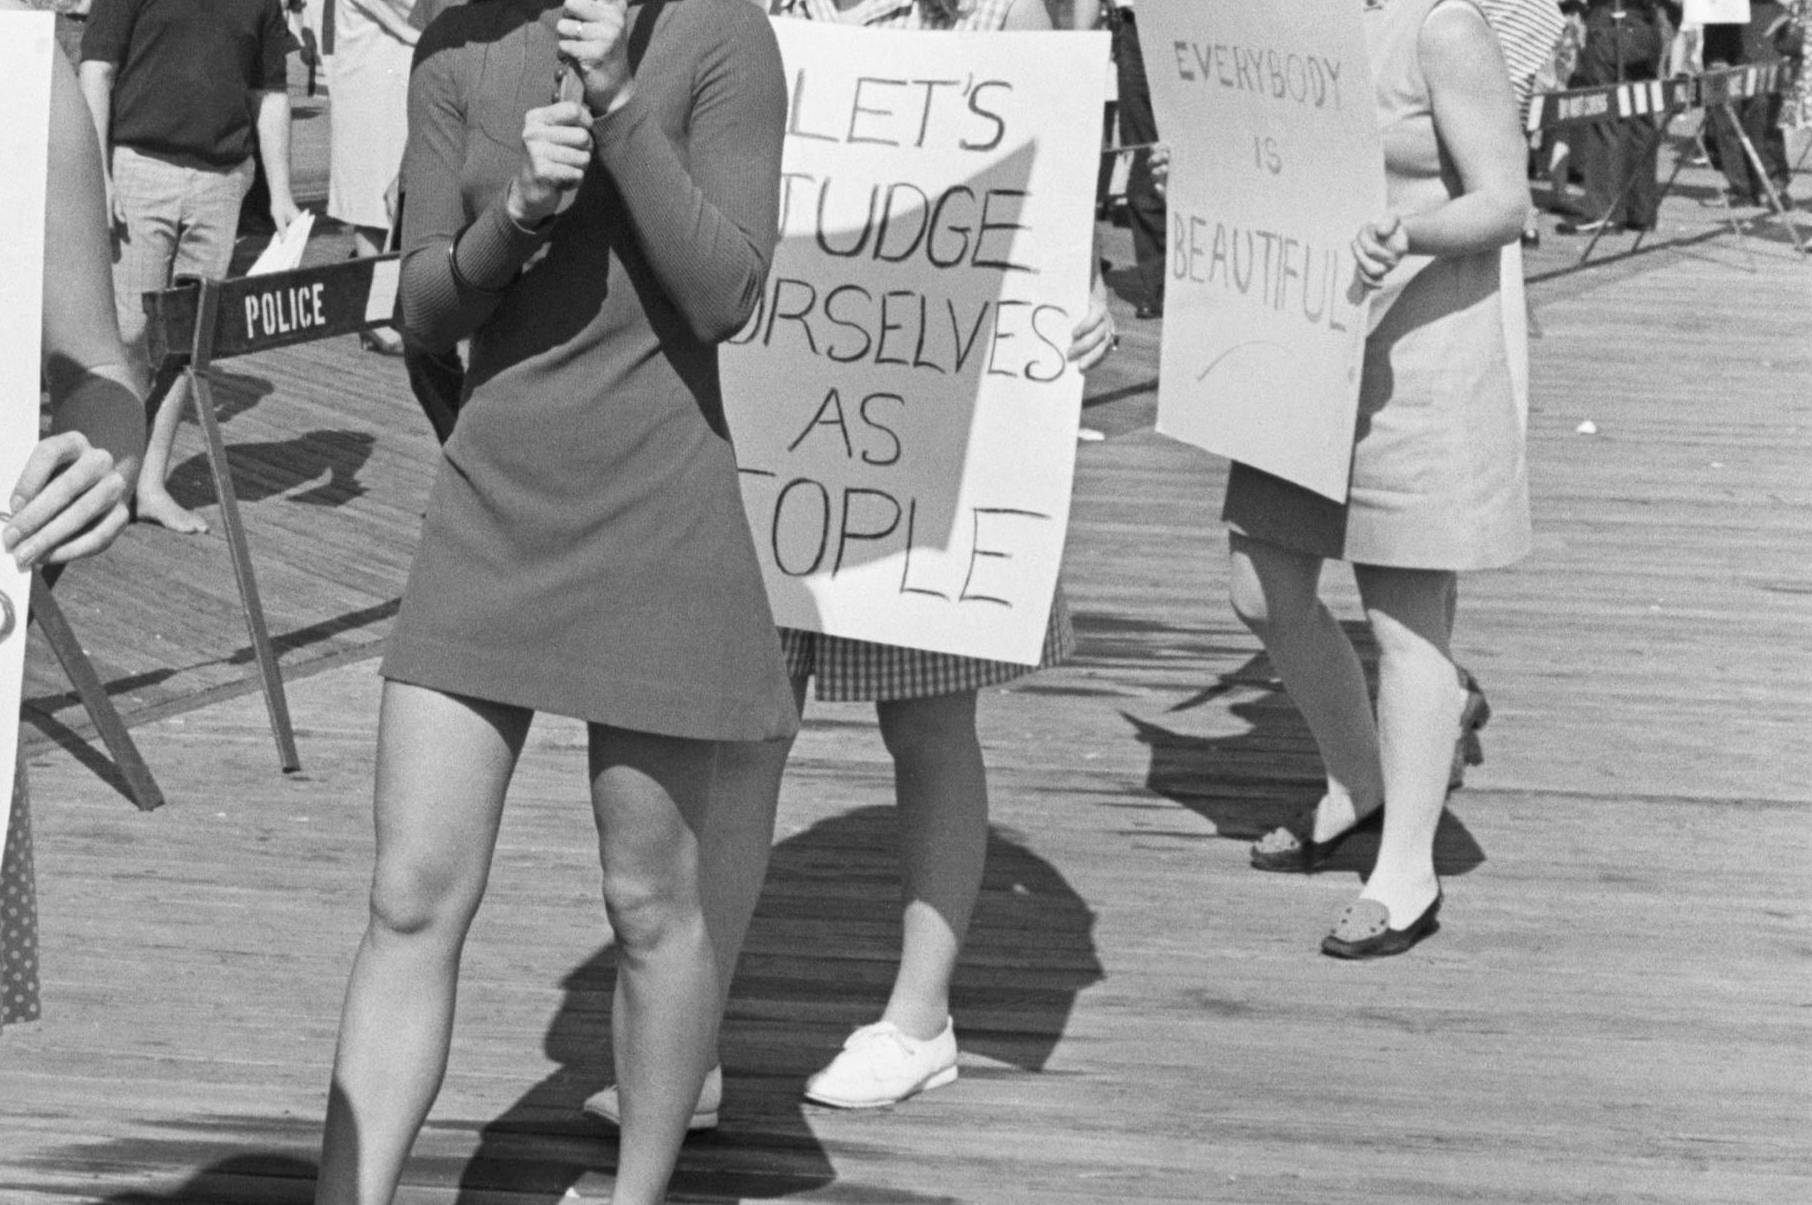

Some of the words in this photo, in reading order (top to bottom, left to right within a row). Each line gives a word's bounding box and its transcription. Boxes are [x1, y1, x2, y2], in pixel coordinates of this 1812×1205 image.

[786, 68, 1013, 151] LET'S
[1173, 40, 1340, 109] EVERYBODY
[1254, 135, 1282, 175] IS
[1172, 210, 1346, 332] BEAUTIFUL
[245, 283, 326, 339] POLICE
[788, 388, 905, 466] AS
